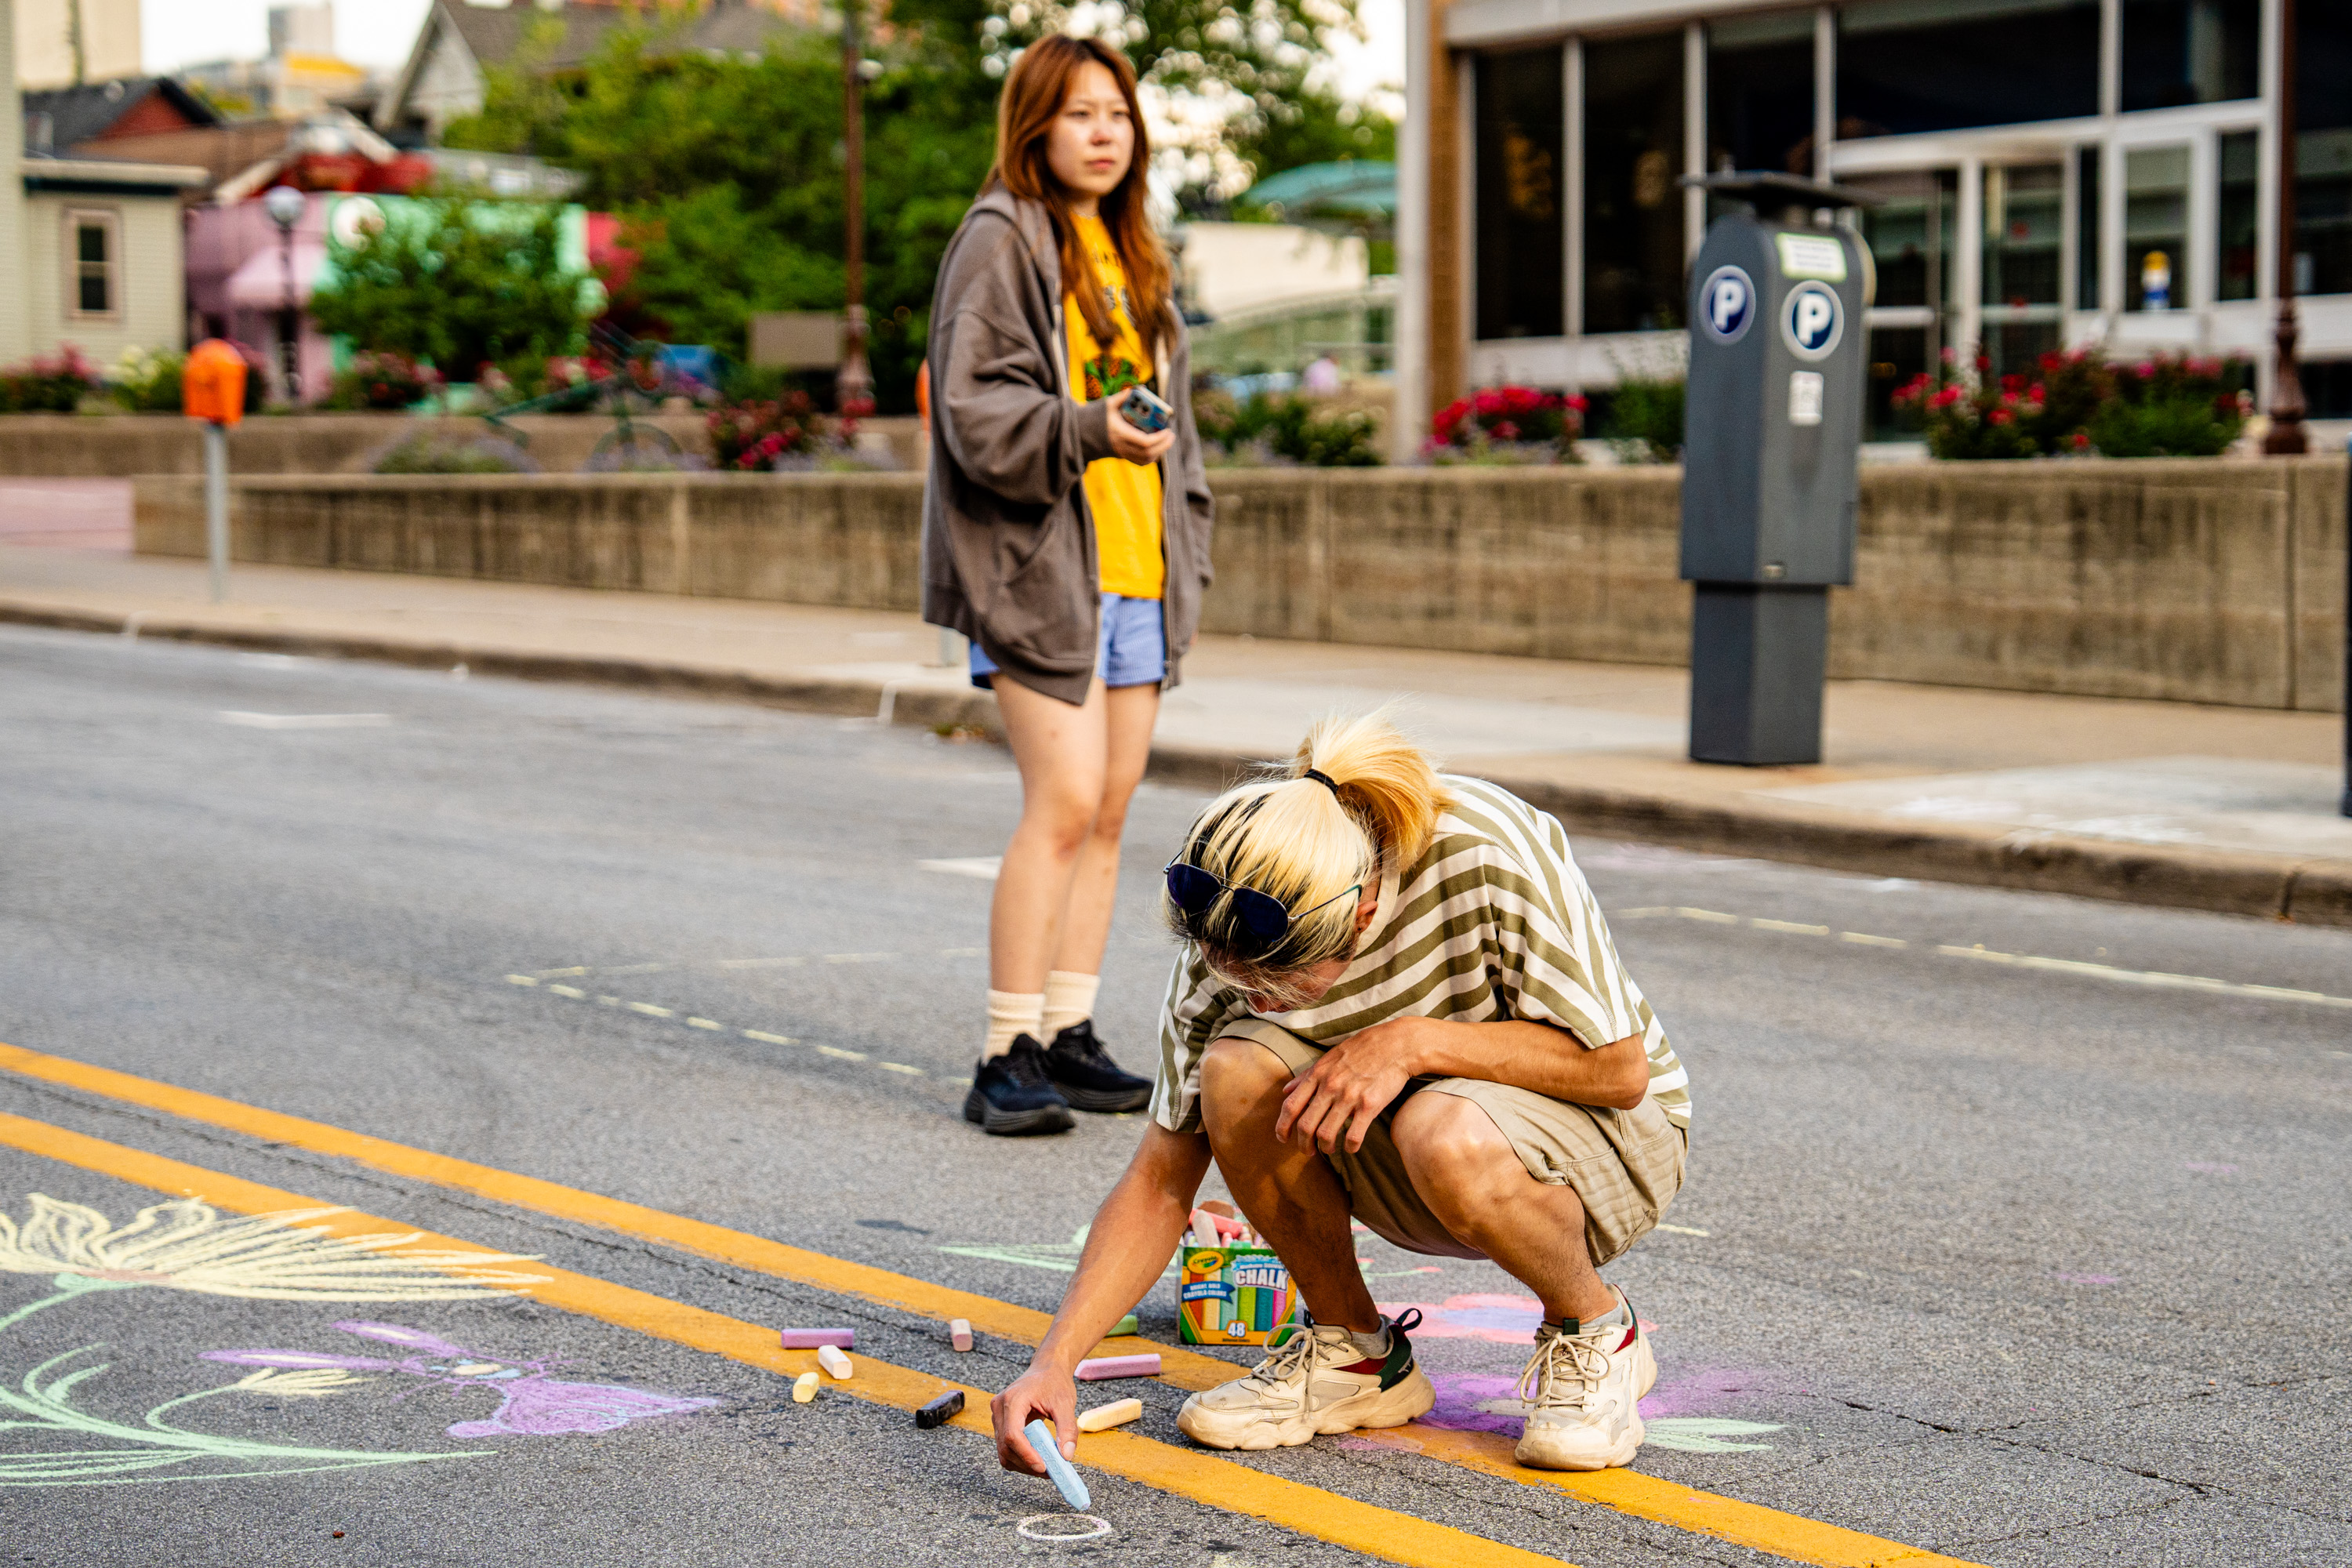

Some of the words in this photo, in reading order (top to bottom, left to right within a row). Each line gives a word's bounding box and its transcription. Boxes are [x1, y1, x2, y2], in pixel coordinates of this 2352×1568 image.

[1713, 279, 1746, 330] P
[1797, 292, 1832, 346] P
[1236, 1269, 1287, 1290] CHALK
[1228, 1322, 1246, 1337] 48
